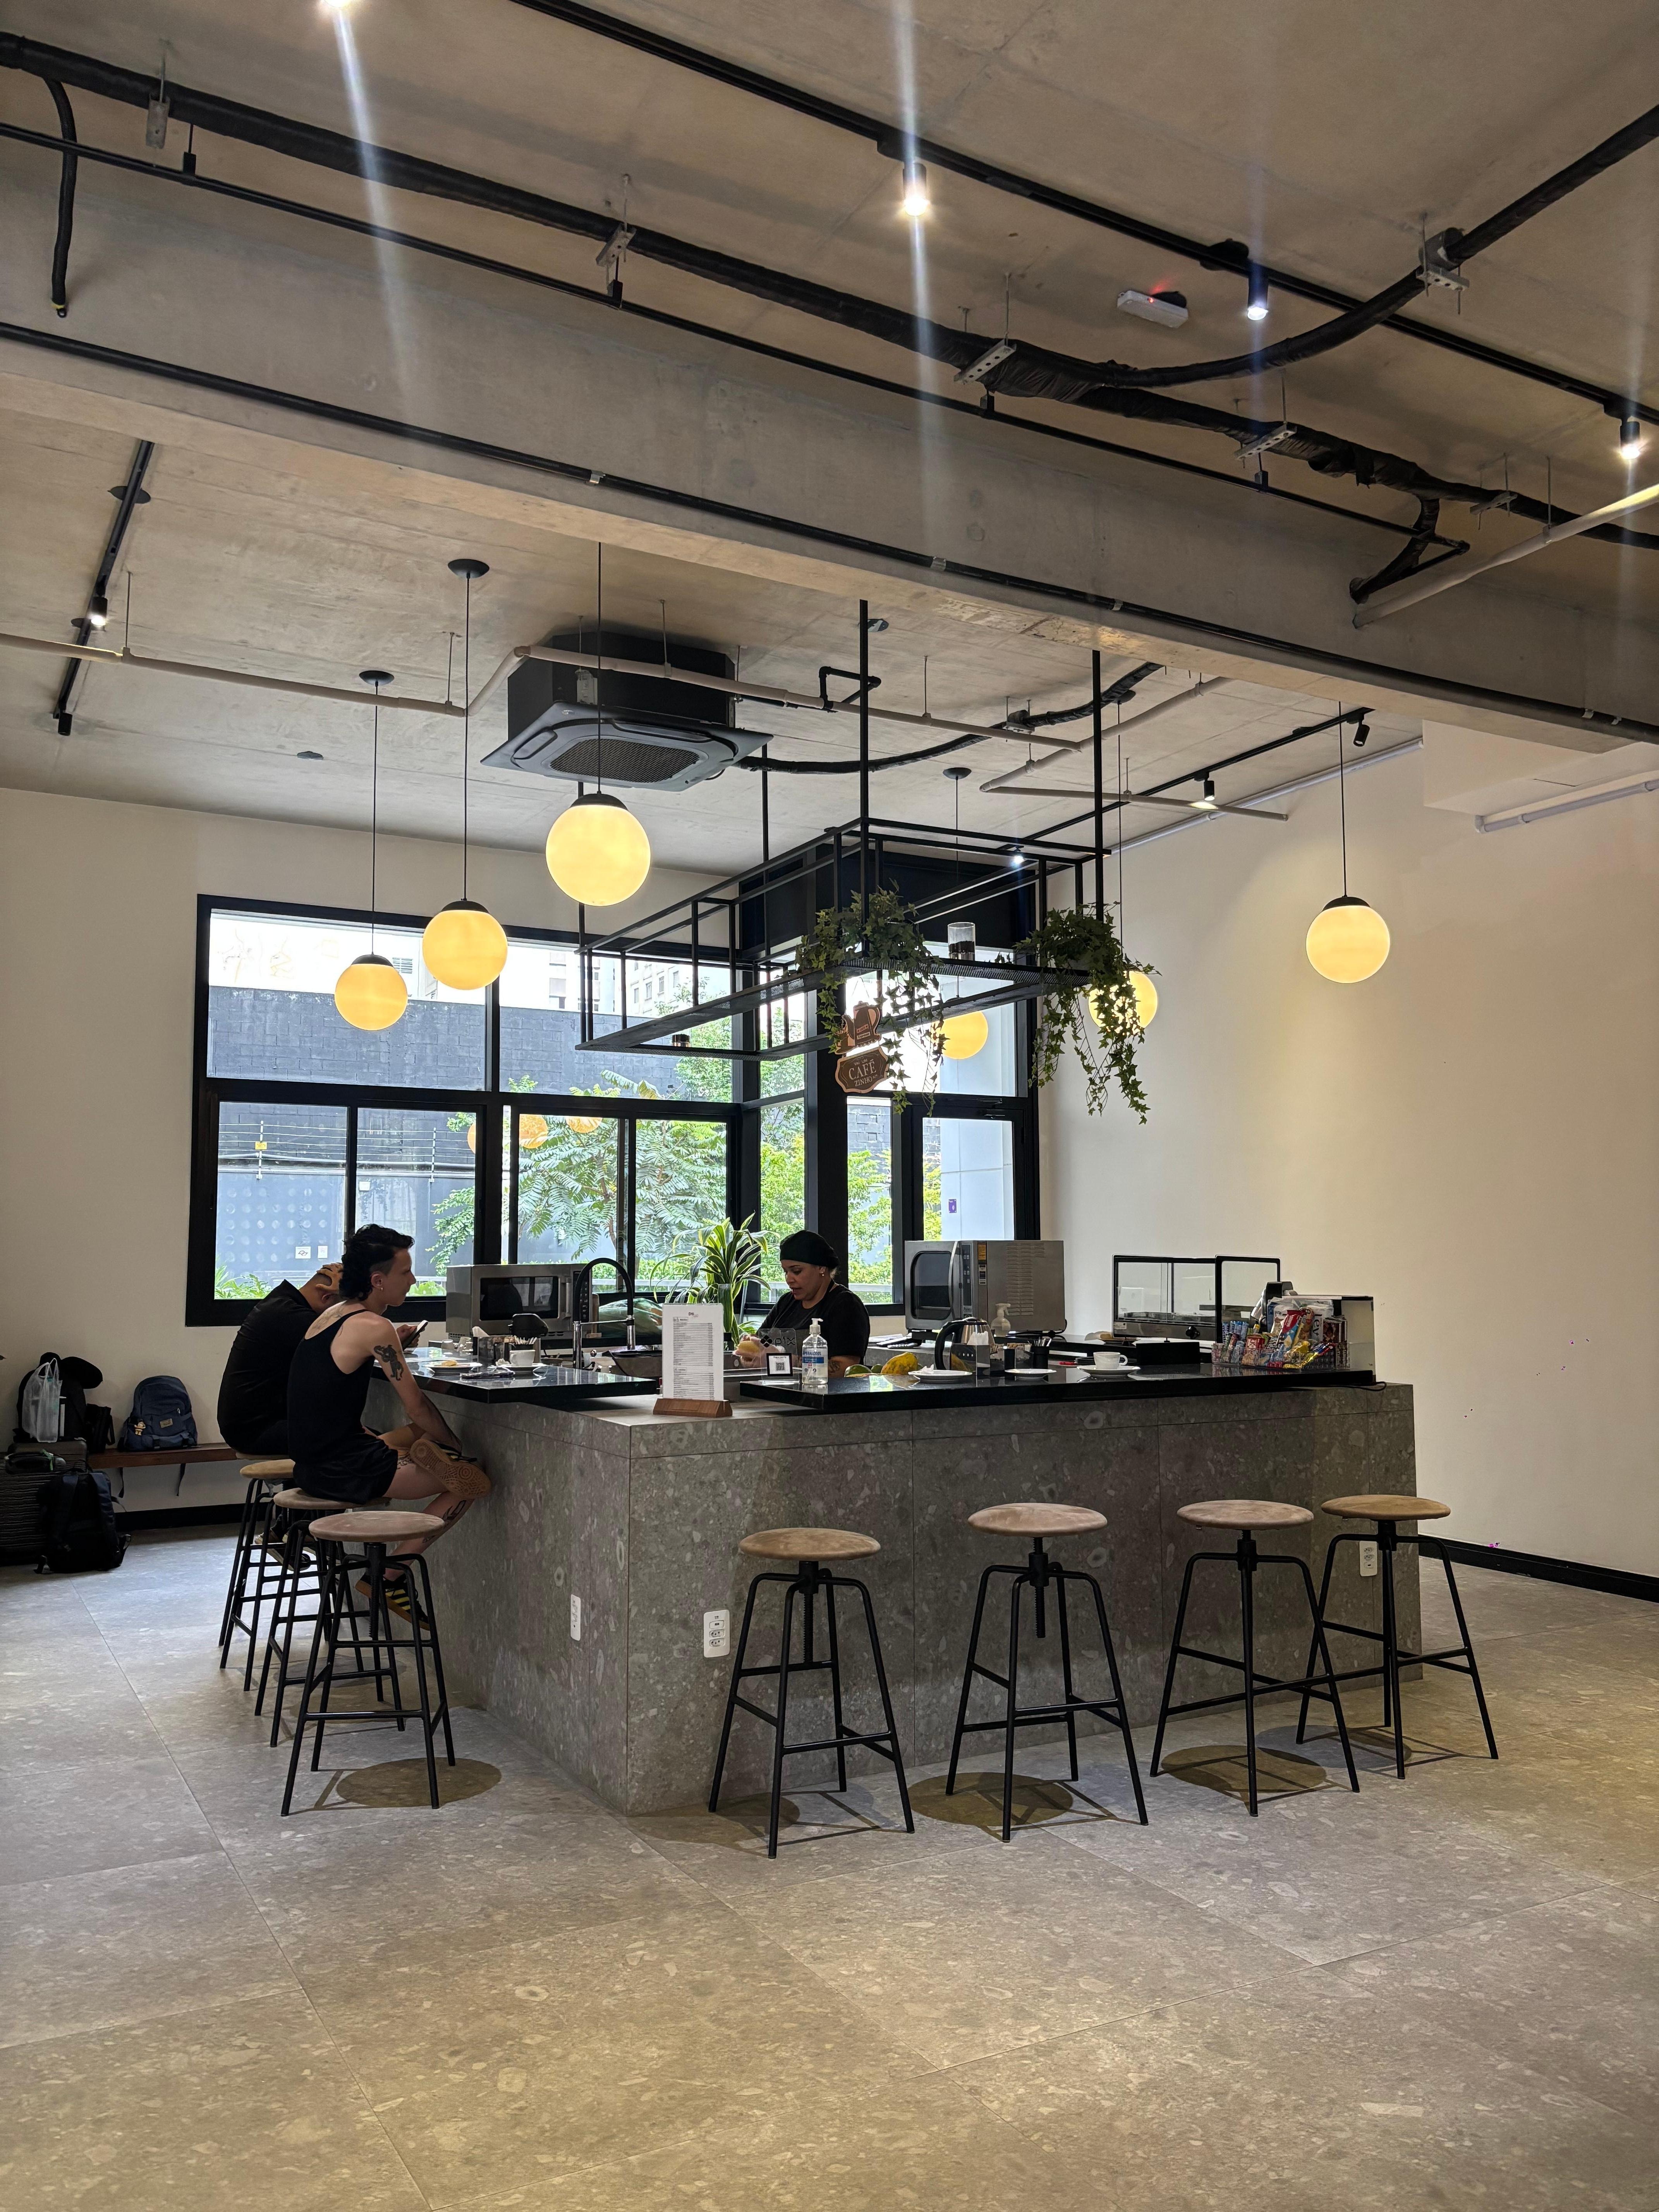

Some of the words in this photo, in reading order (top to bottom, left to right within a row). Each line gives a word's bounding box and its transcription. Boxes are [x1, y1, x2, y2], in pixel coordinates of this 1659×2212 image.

[849, 1059, 876, 1080] CAFÉ
[854, 1076, 872, 1087] ZINHO
[775, 1336, 795, 1346] pix
